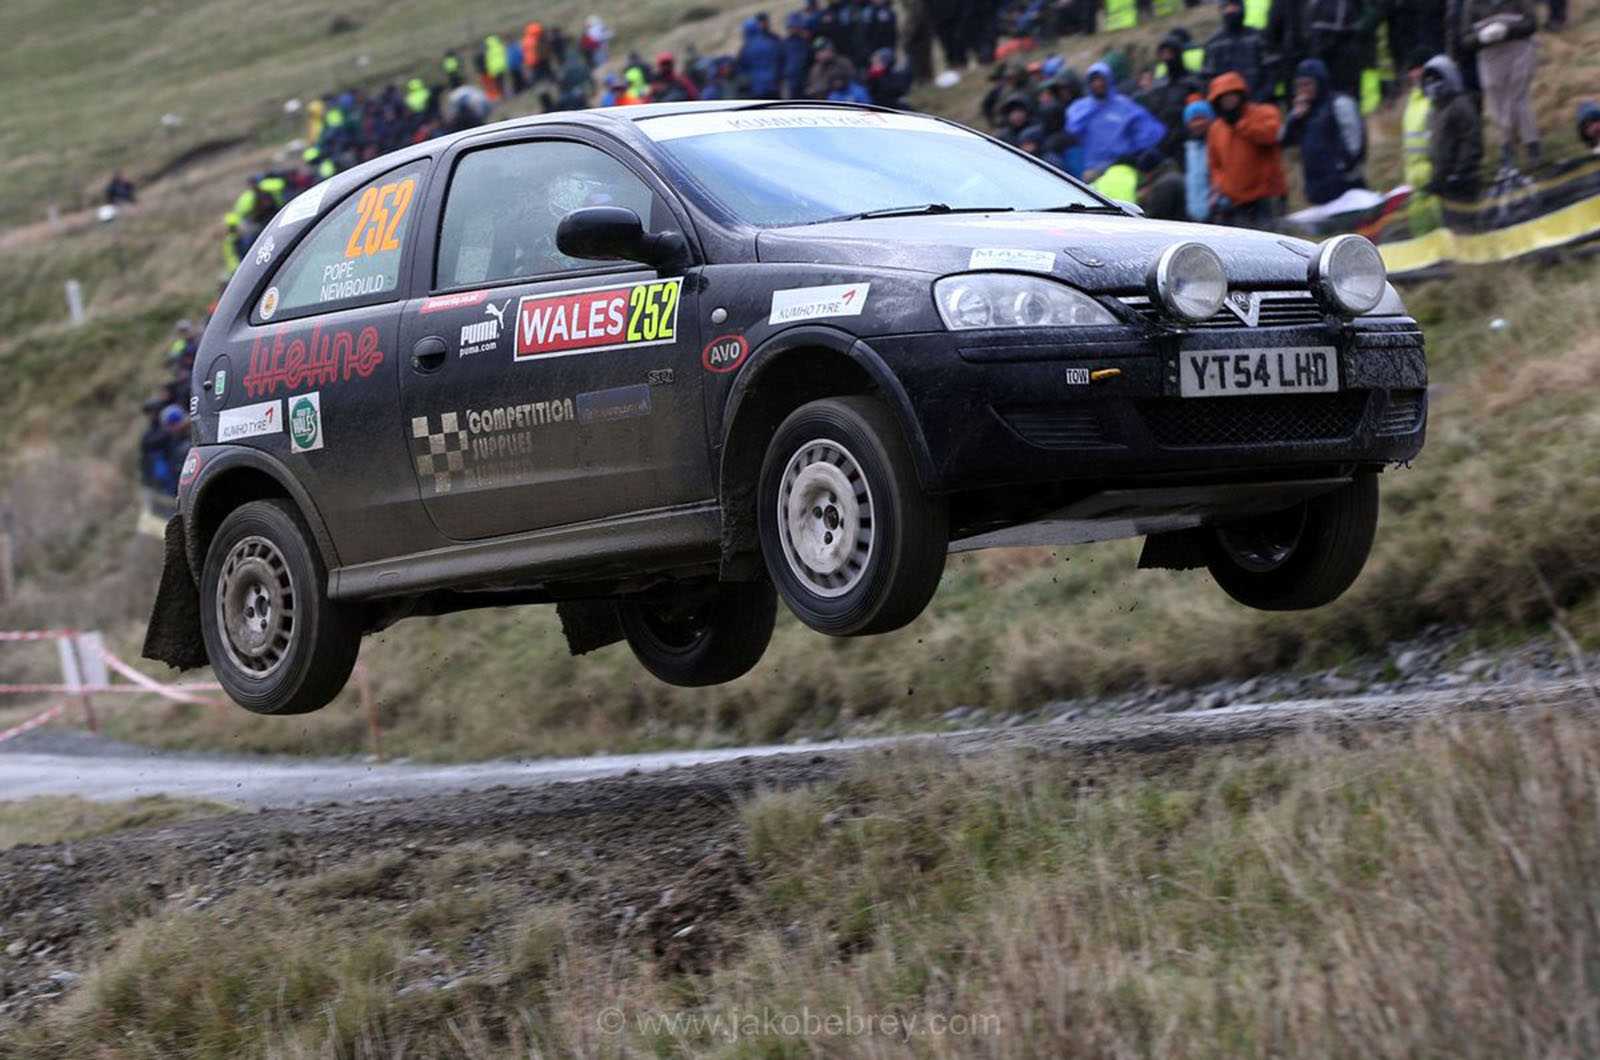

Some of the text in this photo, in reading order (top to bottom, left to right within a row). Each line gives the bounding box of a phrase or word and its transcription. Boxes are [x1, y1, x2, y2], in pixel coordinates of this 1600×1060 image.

[345, 178, 416, 259] 252
[323, 260, 355, 283] POPE
[319, 274, 384, 302] NEWBOULD
[522, 281, 679, 346] WALES 252
[778, 301, 841, 319] KUMHO TYRE
[460, 319, 498, 346] PUMA
[459, 342, 497, 358] puma.com
[710, 342, 740, 365] AVO
[1067, 369, 1089, 384] TOW
[1190, 352, 1328, 390] YT54 LHD
[223, 420, 267, 437] KUMHO TYRE
[468, 398, 574, 434] COMPETITION
